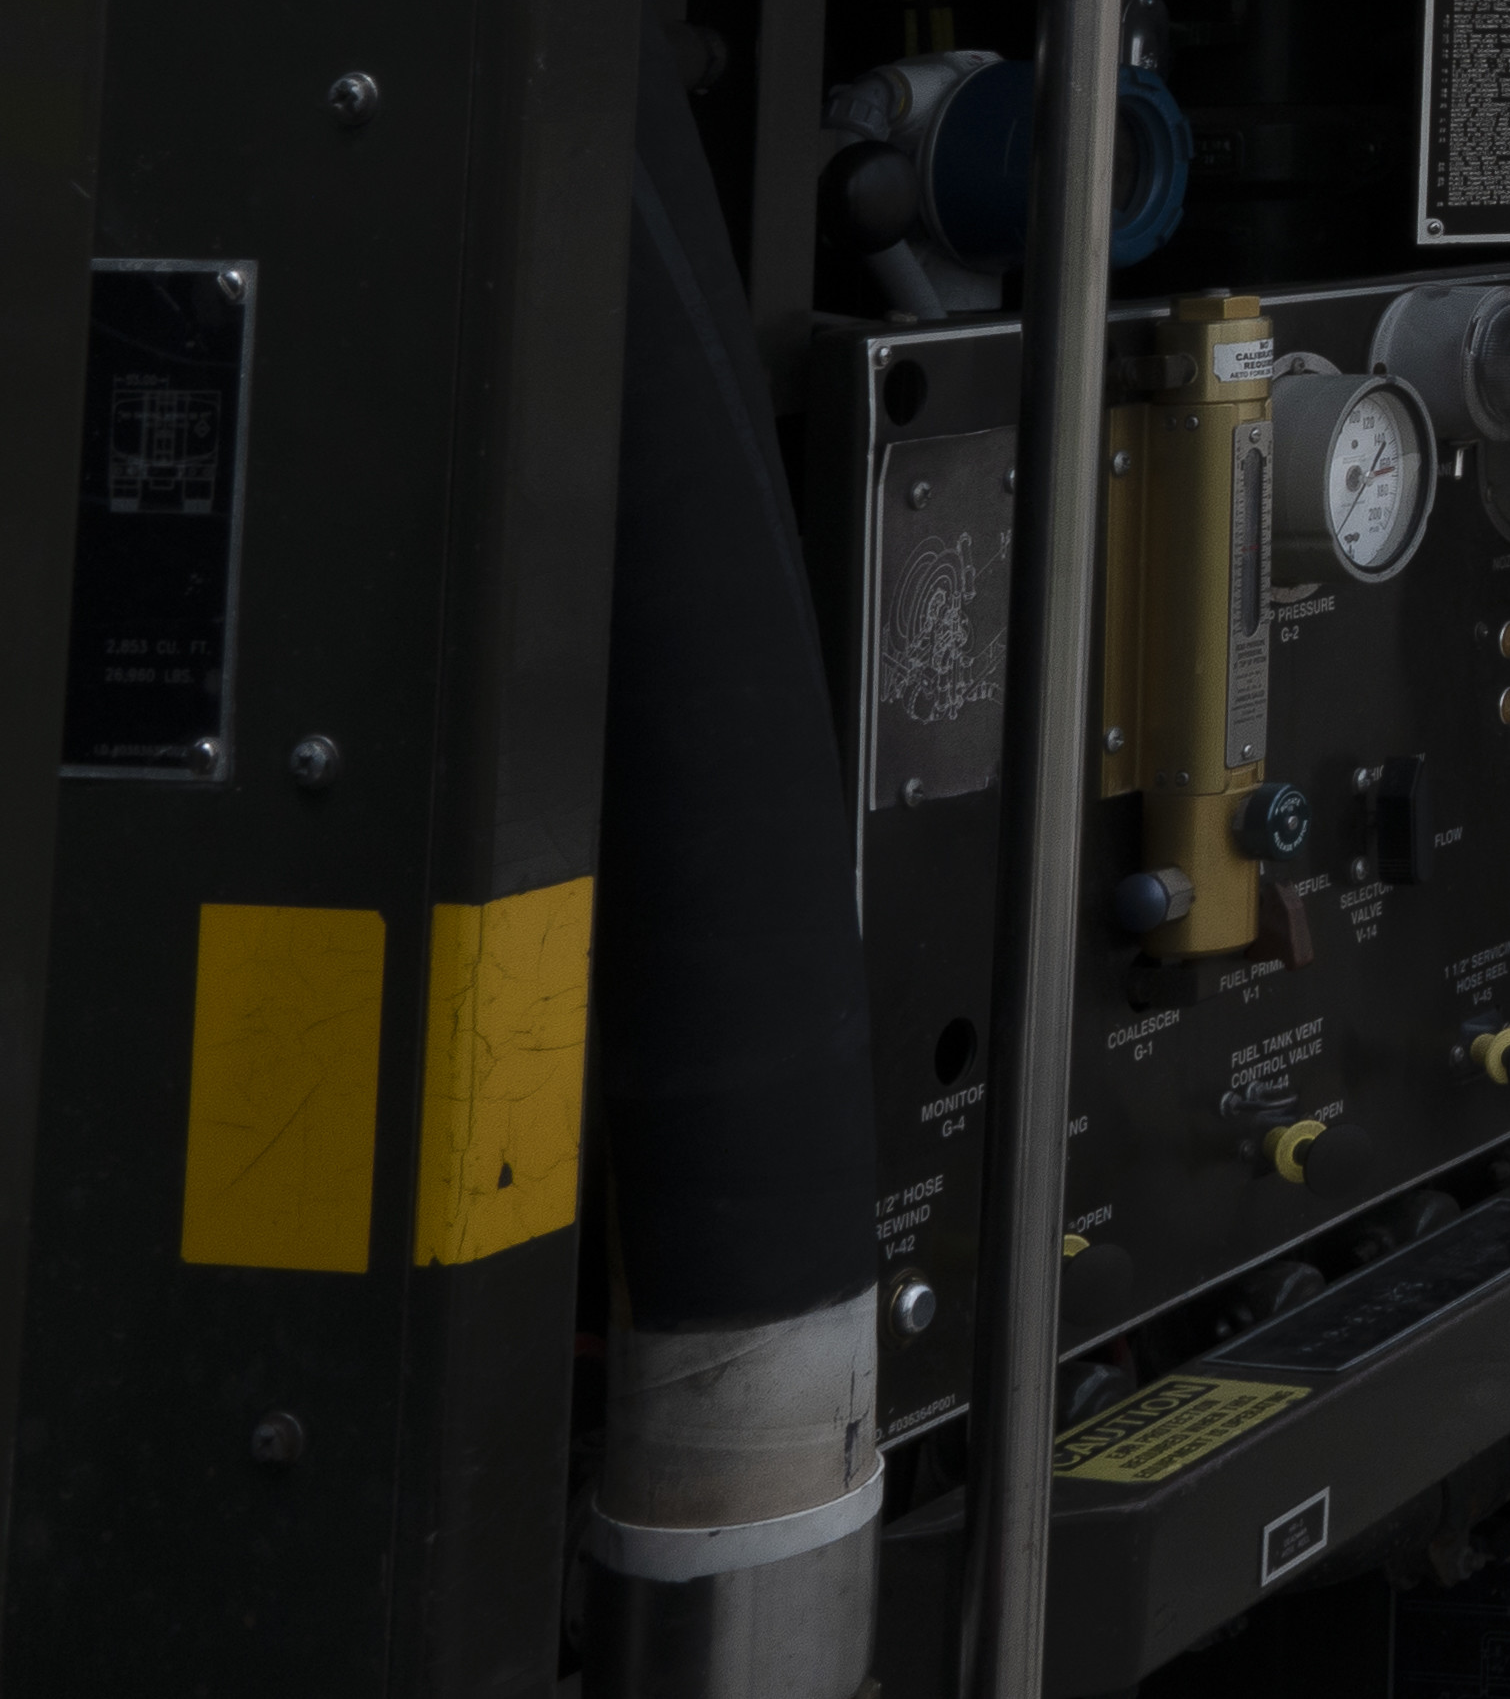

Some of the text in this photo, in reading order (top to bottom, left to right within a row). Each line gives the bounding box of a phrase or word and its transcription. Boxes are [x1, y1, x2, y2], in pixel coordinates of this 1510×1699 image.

[1362, 415, 1375, 430] 120
[1368, 507, 1382, 522] 200
[1277, 595, 1336, 624] PRESSURE
[1281, 625, 1300, 643] G-2
[1434, 827, 1463, 849] FLOW
[1294, 873, 1333, 898] EFUEL
[1350, 901, 1383, 925] VALVE
[1356, 924, 1378, 944] V-14
[1219, 969, 1248, 993] FUEL
[1456, 961, 1509, 996] HOSE REEL
[1243, 985, 1260, 1005] V-1
[1134, 1040, 1154, 1062] G-1
[1231, 1016, 1324, 1069] FUEL TANK VENT
[1230, 1038, 1323, 1090] CONTROL VALVE
[941, 1115, 966, 1138] G-4
[903, 1173, 944, 1206] HOSE
[1077, 1203, 1113, 1233] OPEN
[884, 1234, 917, 1262] V-42
[1053, 1382, 1210, 1469] CAUTION
